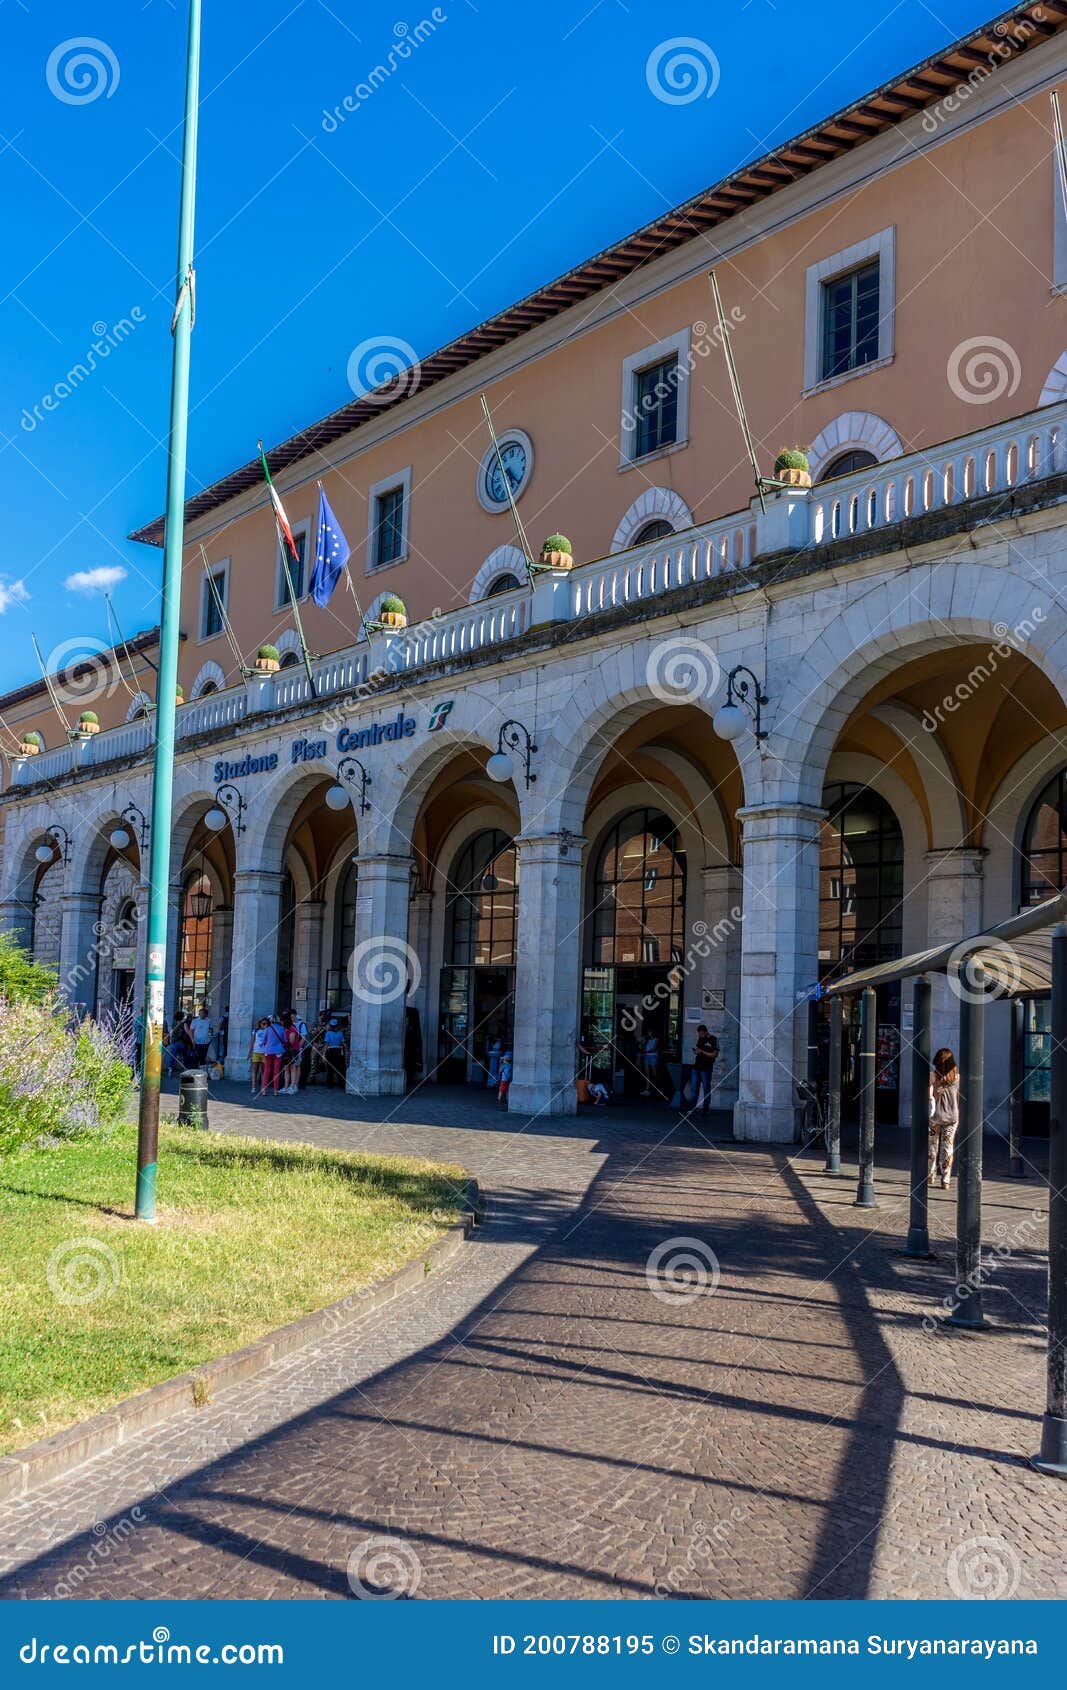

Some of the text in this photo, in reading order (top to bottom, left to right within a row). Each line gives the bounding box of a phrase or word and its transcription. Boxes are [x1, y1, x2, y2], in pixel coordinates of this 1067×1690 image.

[213, 712, 416, 783] Stazione Pisa Centrale
